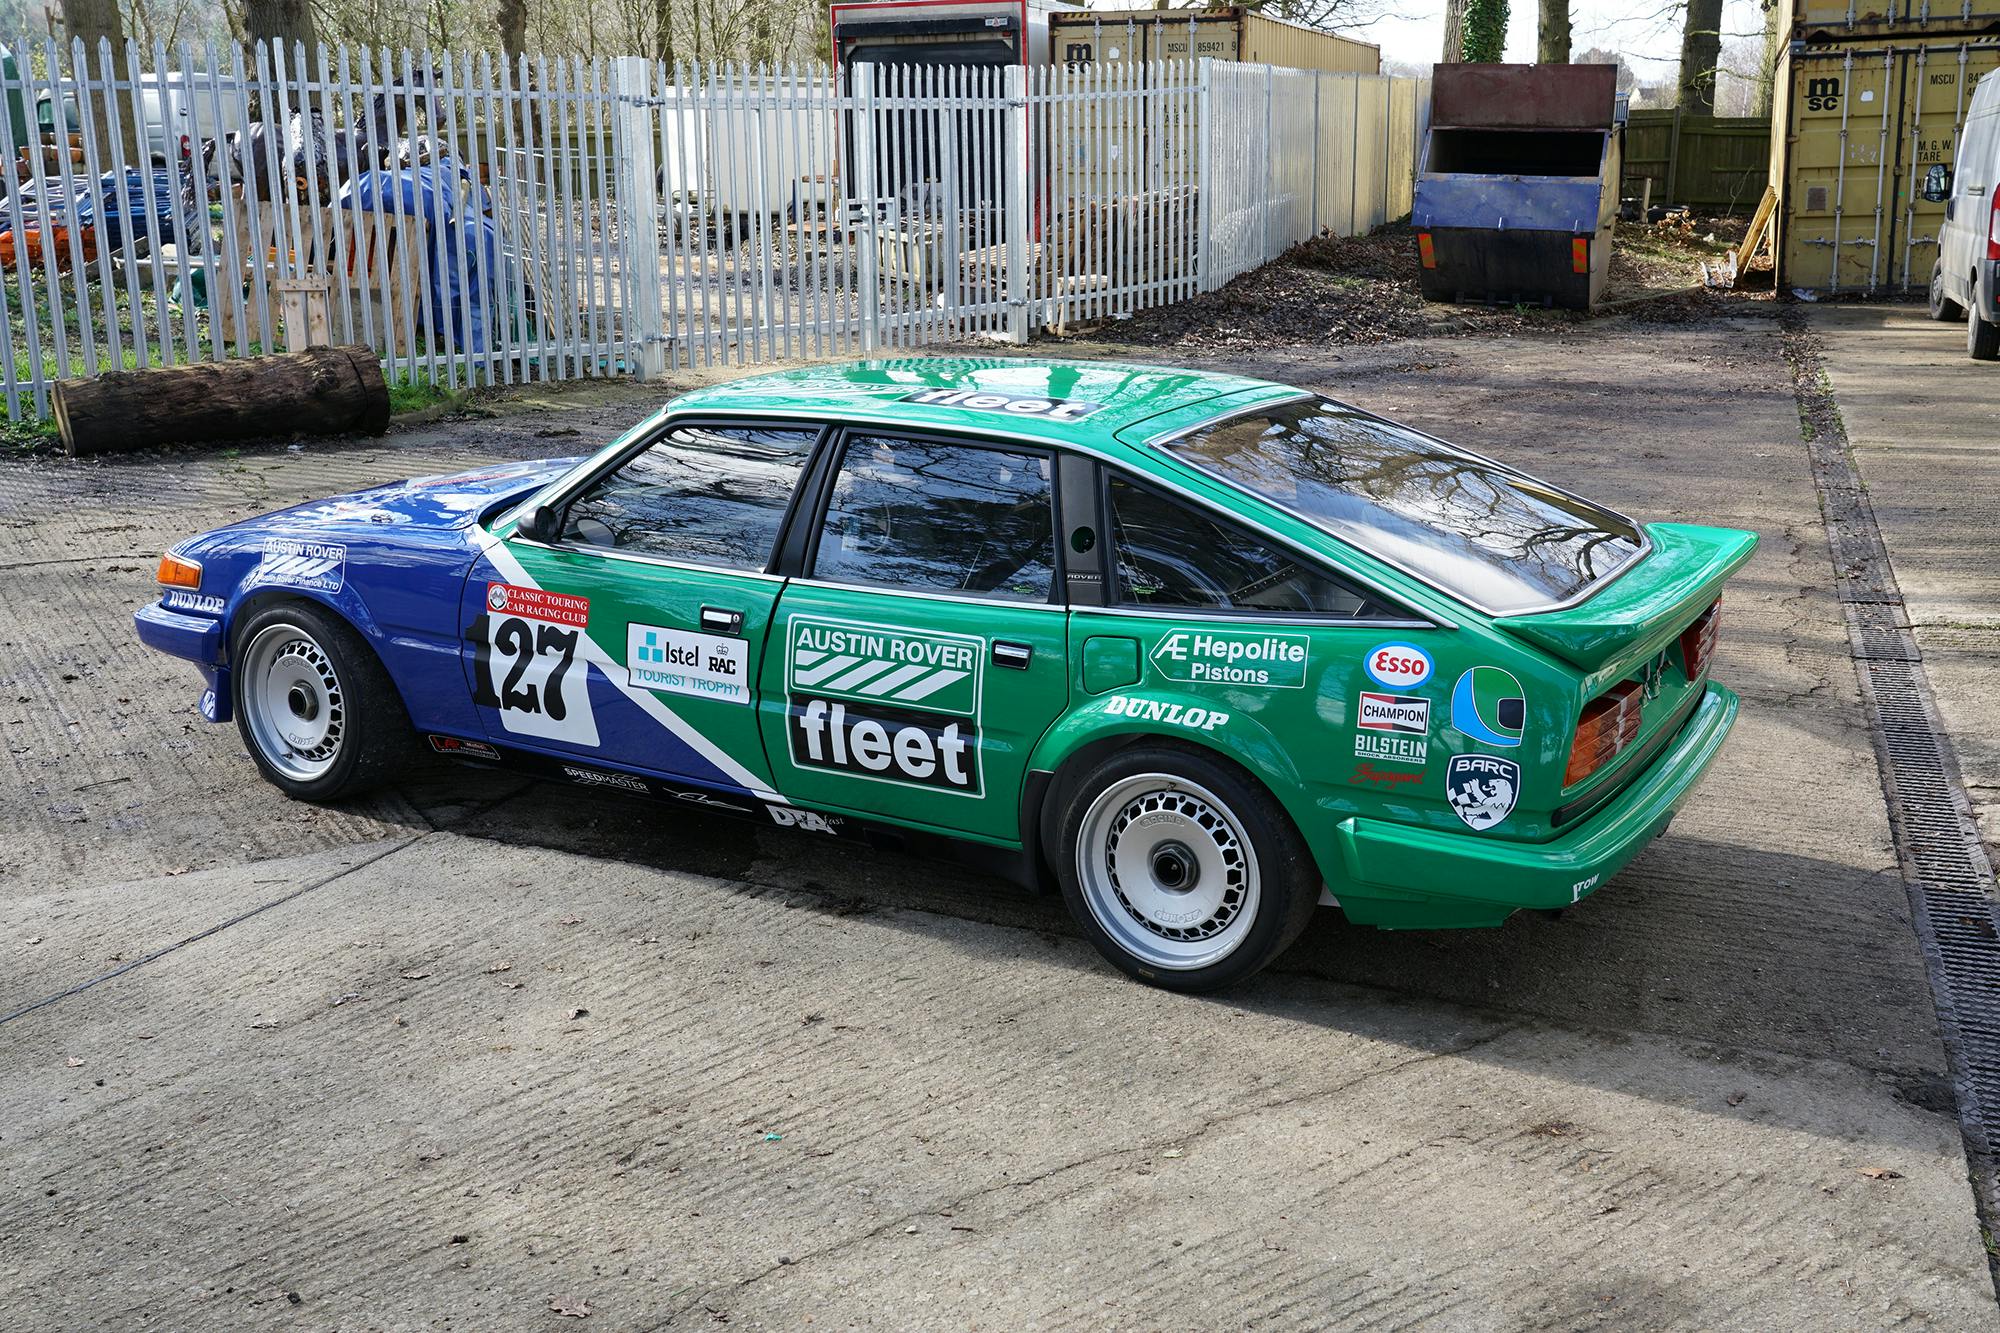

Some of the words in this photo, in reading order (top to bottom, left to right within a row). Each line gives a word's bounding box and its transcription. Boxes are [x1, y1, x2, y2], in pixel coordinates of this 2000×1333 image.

[1167, 43, 1188, 53] MSCU
[1197, 41, 1224, 52] 859421
[1930, 73, 1955, 85] MSCU
[1917, 151, 1941, 162] TARE
[914, 389, 1087, 418] fleet
[265, 541, 305, 556] AUSTIN
[305, 545, 344, 560] ROVER
[322, 581, 340, 590] LTD
[168, 591, 225, 614] DUNLOP
[506, 588, 545, 606] CLASSIC
[546, 594, 588, 612] TOURING
[506, 602, 526, 614] CAR
[526, 604, 560, 621] RACING
[561, 610, 588, 625] CLUB
[665, 641, 700, 668] Istel
[796, 628, 884, 659] AUSTIN
[890, 639, 973, 670] ROVER
[1192, 635, 1305, 664] Hepolite
[465, 613, 579, 721] 127
[708, 656, 736, 675] RAC
[1191, 662, 1269, 684] Pistons
[637, 668, 687, 688] TOURIST
[691, 677, 741, 697] TROPHY
[1103, 695, 1230, 731] DUNLOP
[1363, 704, 1425, 722] CHAMPION
[799, 699, 968, 785] fleet
[1355, 734, 1428, 758] BILSTEIN
[1383, 755, 1424, 763] ABSORBERS
[1456, 759, 1513, 780] BARC
[564, 767, 649, 792] SPEEDMASTER
[1576, 873, 1600, 892] TOW
